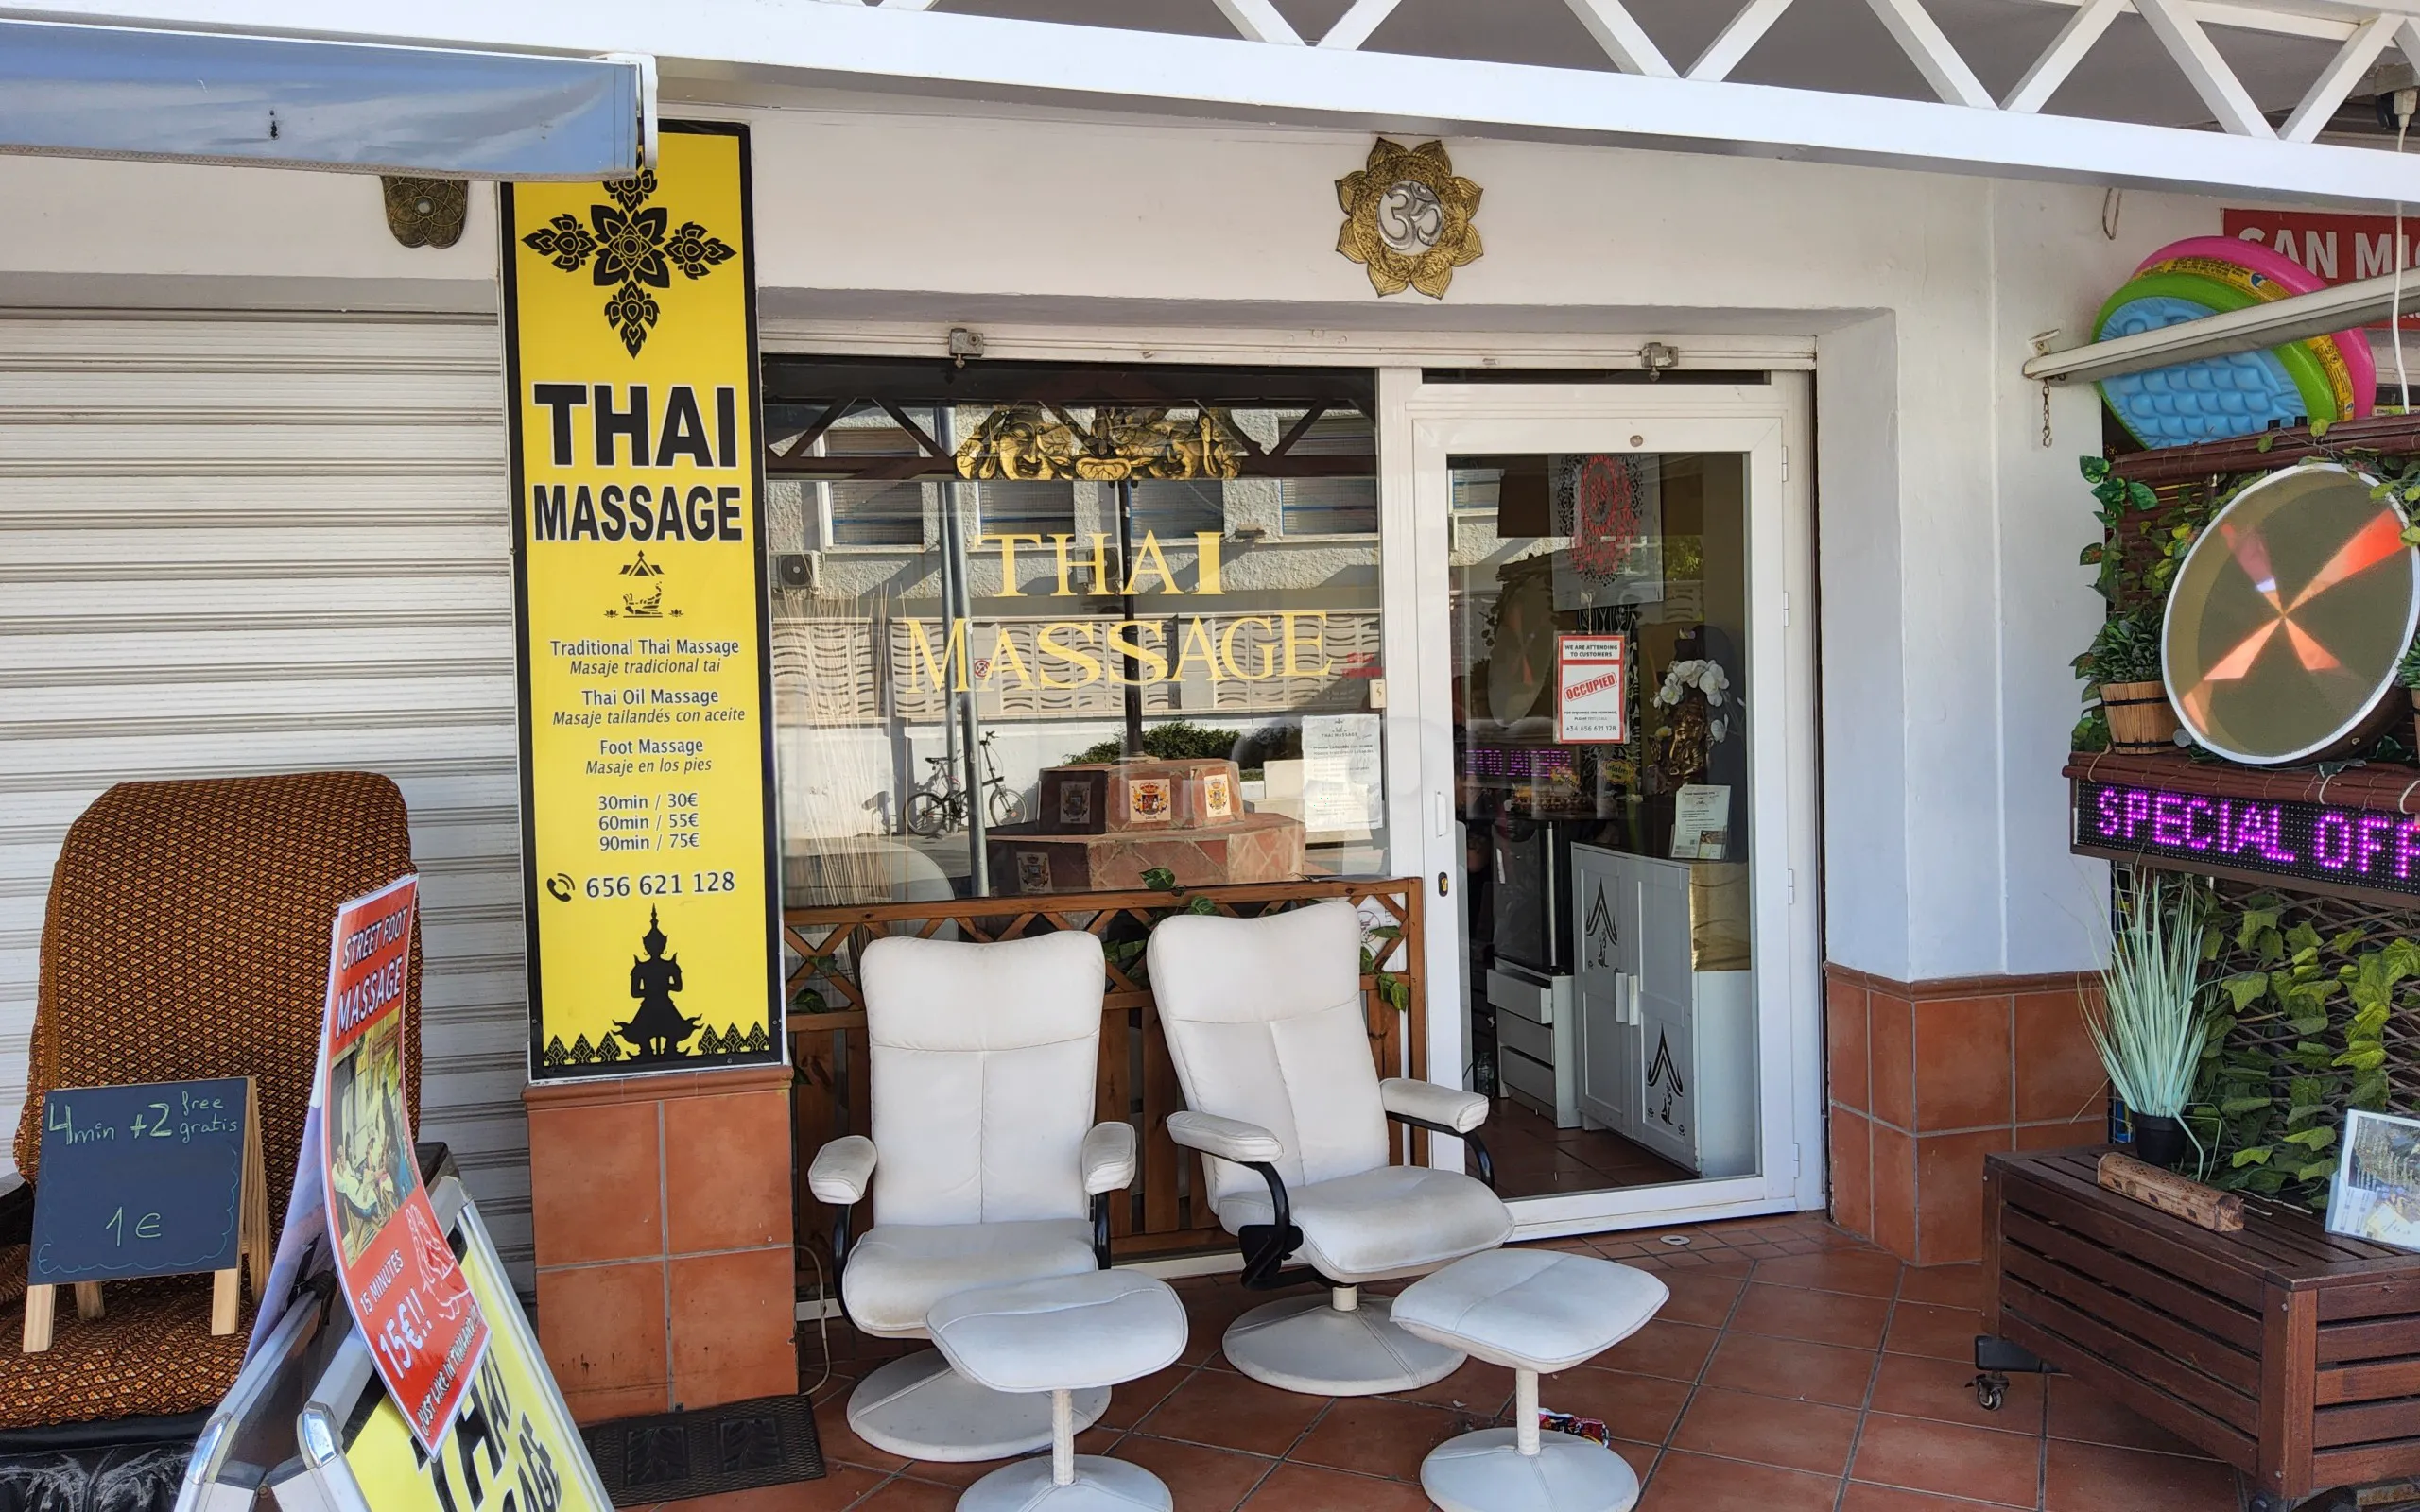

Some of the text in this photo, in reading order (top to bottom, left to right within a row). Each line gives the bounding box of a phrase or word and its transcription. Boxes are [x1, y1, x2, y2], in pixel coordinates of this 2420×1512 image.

[2238, 227, 2338, 279] AN
[533, 383, 738, 469] THAI
[533, 484, 743, 541] MASSAGE
[975, 529, 1226, 598] THAI
[550, 639, 739, 657] Traditional Thai Massage
[904, 610, 1333, 694] MASSAGE
[570, 658, 721, 677] Masaje tradicional tai
[581, 689, 719, 707] Thai Oil Massage
[1565, 674, 1616, 700] OCCUPIED
[553, 707, 745, 728] Masaje tailandés con aceite
[600, 738, 703, 756] Foot Massage
[586, 757, 712, 777] Masaje en los pies
[598, 792, 700, 811] 30min / 30€
[598, 813, 700, 831] 60min / 55€
[2099, 787, 2296, 863] SPECIAL
[598, 833, 700, 850] 90min / 75€
[586, 871, 735, 898] 656 621 128
[342, 906, 408, 971] STREET FOOT
[336, 954, 404, 1039] MASSAGE
[182, 1091, 224, 1116] free
[179, 1113, 237, 1143] gratis
[360, 1247, 405, 1316] 15 MINUTES
[379, 1286, 433, 1380] 15€!!
[416, 1392, 437, 1437] JUST
[430, 1369, 451, 1405] LIKE
[442, 1359, 457, 1382] IN
